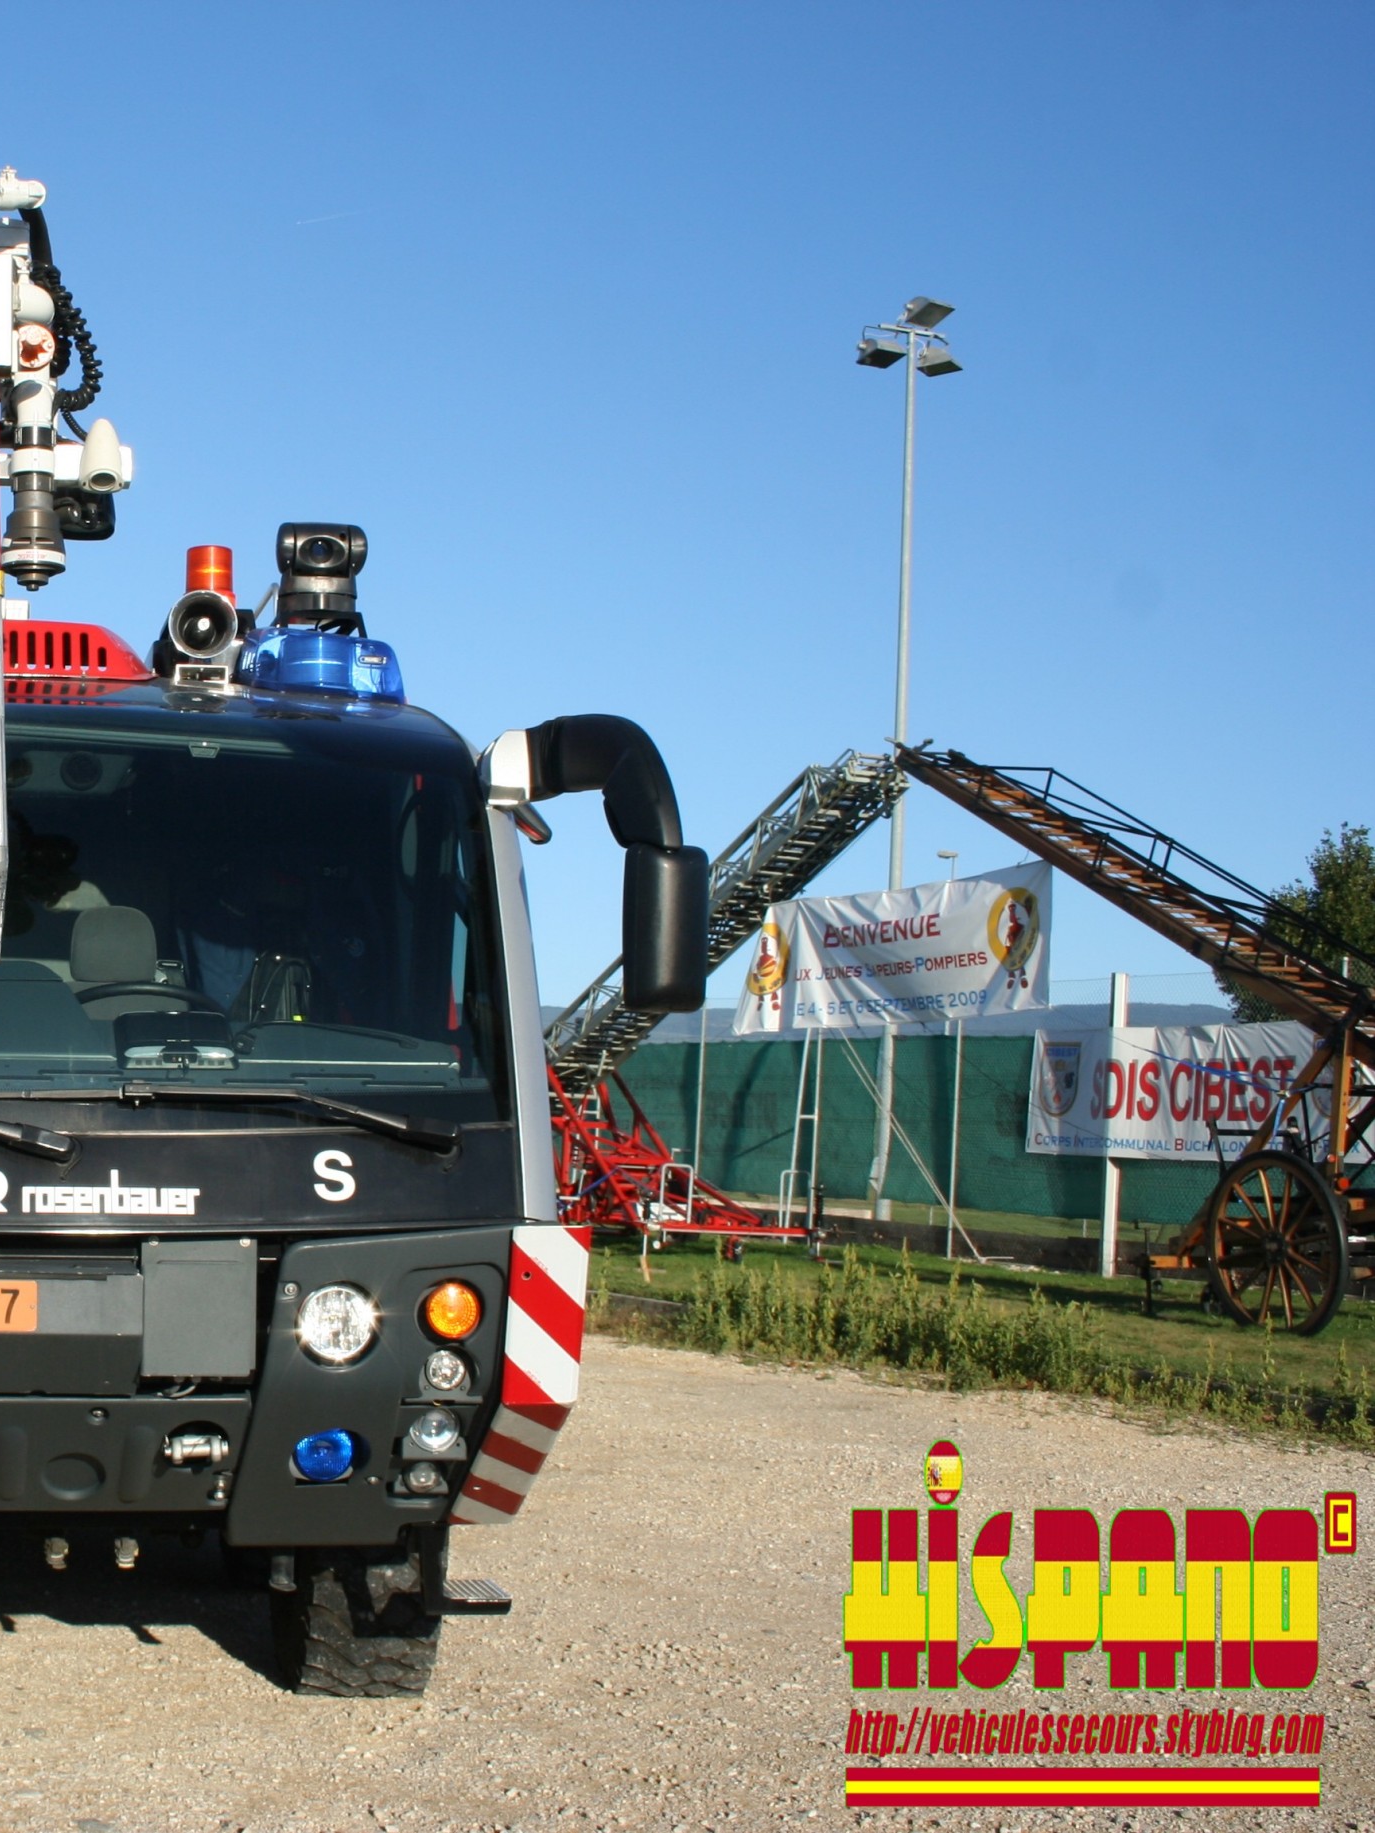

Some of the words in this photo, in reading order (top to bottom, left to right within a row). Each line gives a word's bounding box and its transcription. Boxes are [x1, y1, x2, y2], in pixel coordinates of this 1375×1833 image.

[823, 912, 941, 948] BIENVENUE
[794, 968, 813, 982] UX
[815, 965, 863, 982] JEUNES
[808, 1002, 816, 1015] 4
[826, 1001, 837, 1016] 5
[838, 1000, 853, 1015] ET
[856, 1000, 864, 1014] 6
[866, 993, 945, 1015] SEPTEMBRE
[947, 989, 988, 1008] 2009
[1090, 1058, 1161, 1122] SDIS
[1169, 1055, 1298, 1123] CIBEST
[1034, 1132, 1072, 1148] CORPS
[1072, 1133, 1172, 1151] INTERCOMMUNAL
[21, 1168, 201, 1215] rosenbauer
[312, 1149, 357, 1202] S
